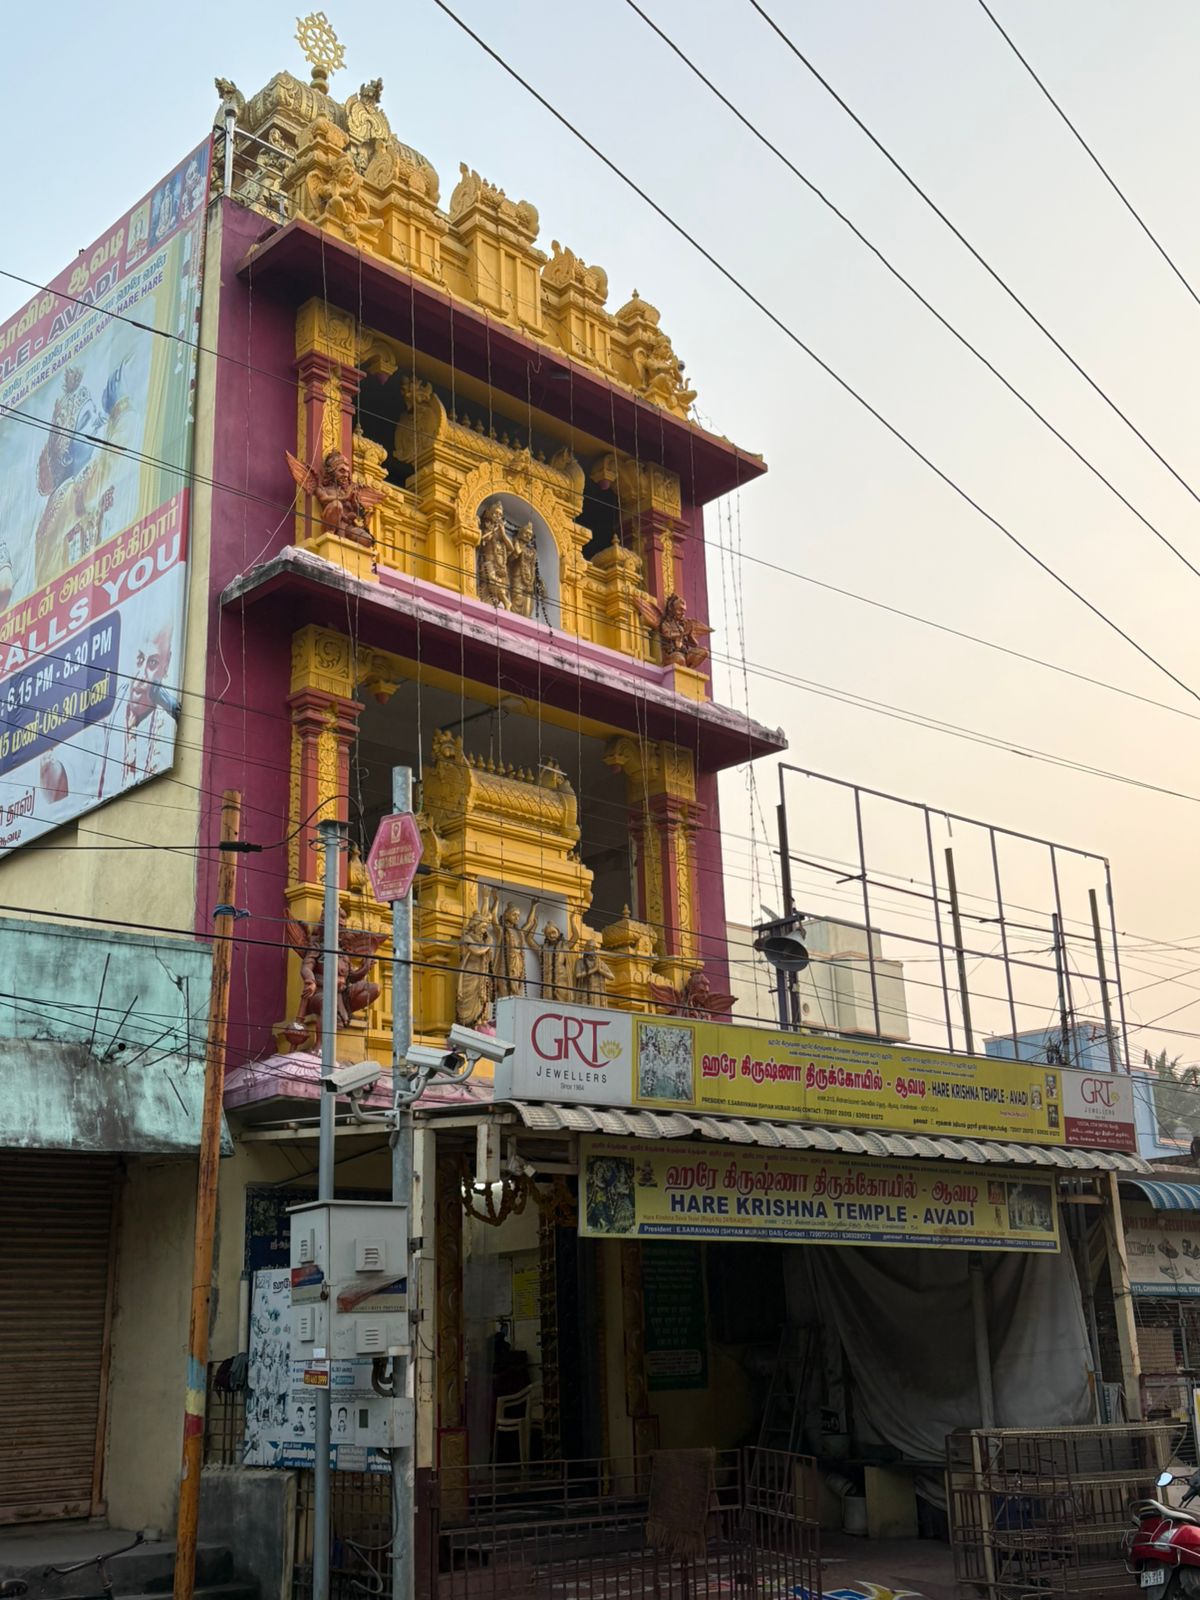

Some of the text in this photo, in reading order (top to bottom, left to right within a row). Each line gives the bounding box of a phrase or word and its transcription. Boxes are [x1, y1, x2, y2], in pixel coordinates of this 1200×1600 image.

[67, 227, 125, 295] ஆவடி
[46, 261, 119, 345] AVADI
[11, 385, 29, 408] RAMA
[31, 367, 50, 390] HARE
[52, 350, 72, 373] RAMA
[74, 332, 94, 355] RAMA
[117, 292, 140, 316] HARE
[141, 271, 163, 297] HARE
[59, 496, 179, 604] அழைக்கிறார்
[0, 531, 181, 674] ALLS YOU
[7, 677, 33, 713] 6.15
[35, 664, 54, 697] PM
[63, 640, 88, 679] 8.30
[92, 626, 113, 661] PM
[80, 668, 111, 714] மணி
[531, 1013, 611, 1069] GRT
[536, 1066, 607, 1084] JEWELLERS
[702, 1053, 737, 1080] ஹரே
[741, 1054, 801, 1085] கிருஷ்ணா
[806, 1061, 883, 1091] திருக்கோயில்
[894, 1075, 926, 1099] ஆவடி
[932, 1081, 950, 1099] HARE
[951, 1083, 979, 1101] KRISHNA
[980, 1086, 1005, 1104] TEMPLE
[1009, 1088, 1029, 1107] AVADI
[1081, 1078, 1115, 1107] GRT
[665, 1161, 719, 1193] ஹரே
[722, 1161, 808, 1196] கிருஷ்ணா
[812, 1167, 918, 1200] திருக்கோயில்
[932, 1180, 979, 1208] ஆவடி
[671, 1194, 729, 1214] HARE
[736, 1196, 828, 1219] KRISHNA
[833, 1201, 908, 1223] TEMPLE
[923, 1207, 975, 1226] AVADI
